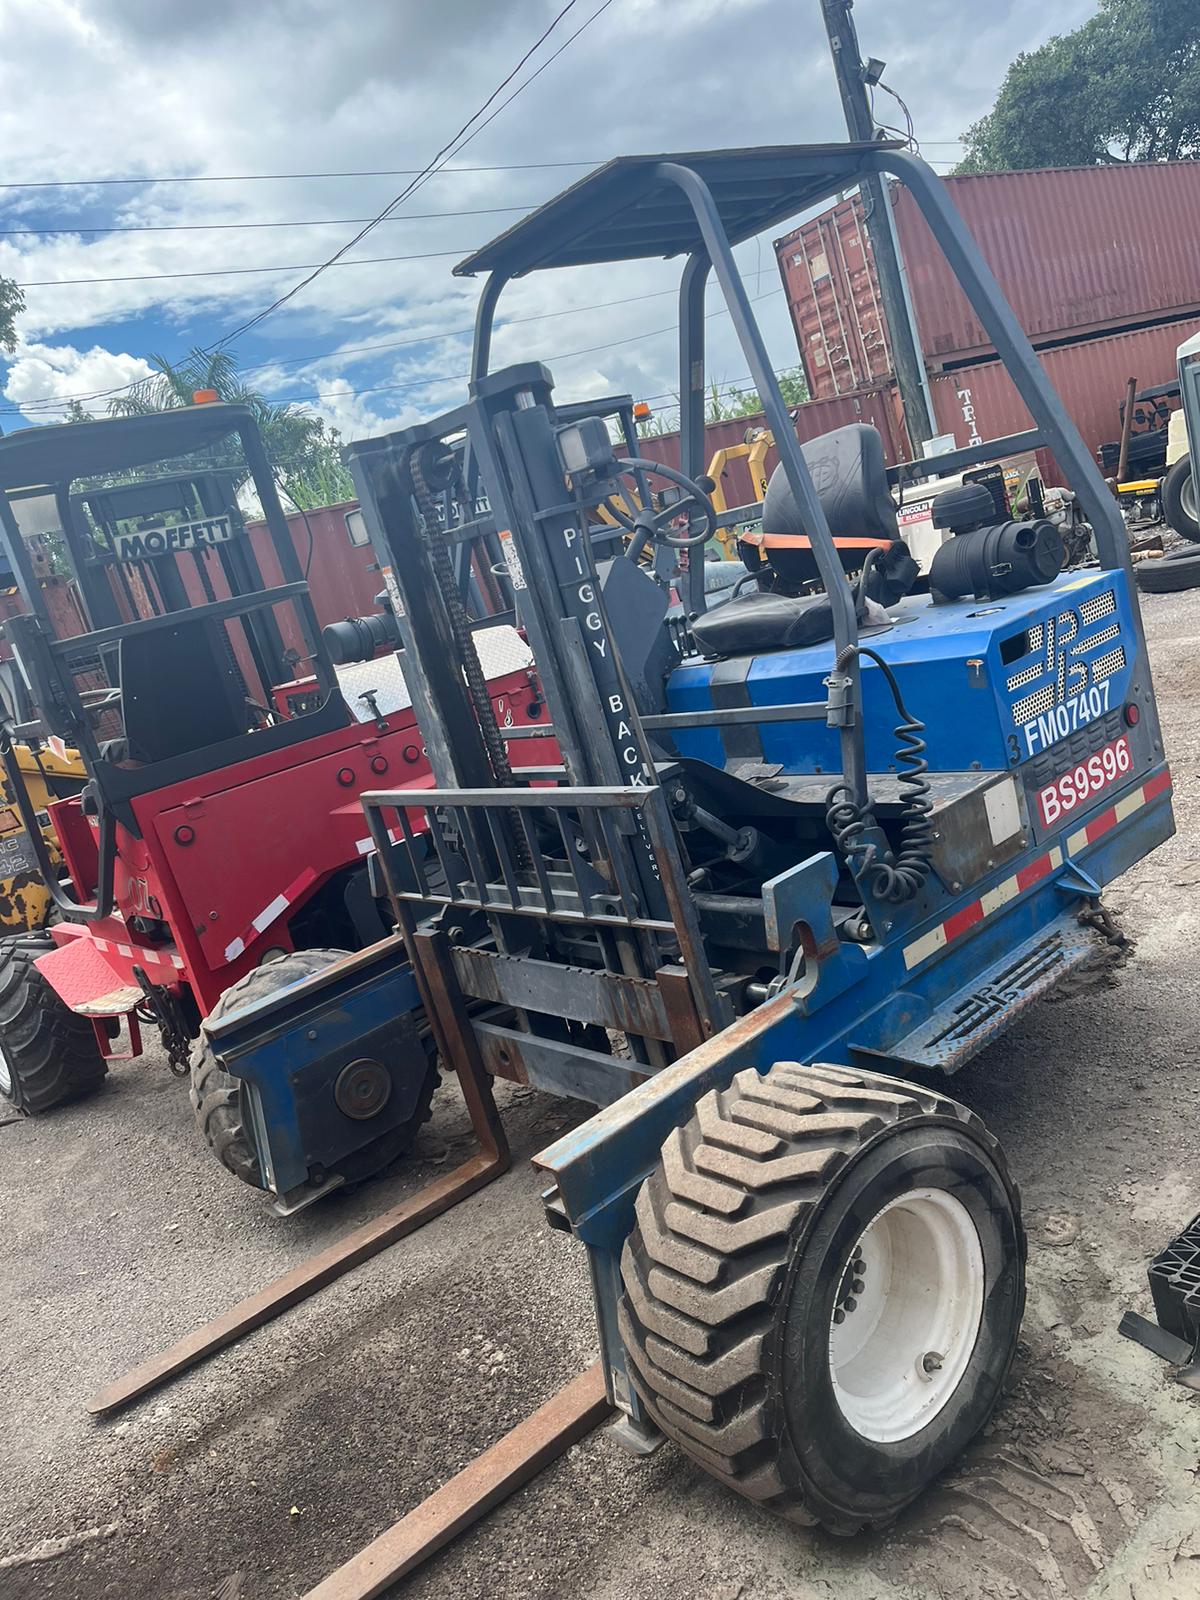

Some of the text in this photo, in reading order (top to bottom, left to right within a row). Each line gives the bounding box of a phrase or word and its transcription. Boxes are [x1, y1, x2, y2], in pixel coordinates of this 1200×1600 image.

[120, 518, 229, 560] MOFFETT
[898, 503, 928, 517] LINCOLN
[563, 527, 646, 787] PIGGY BACK
[1024, 679, 1111, 756] FM07407
[1040, 738, 1130, 825] BS9S96
[634, 806, 661, 881] ELIVERY
